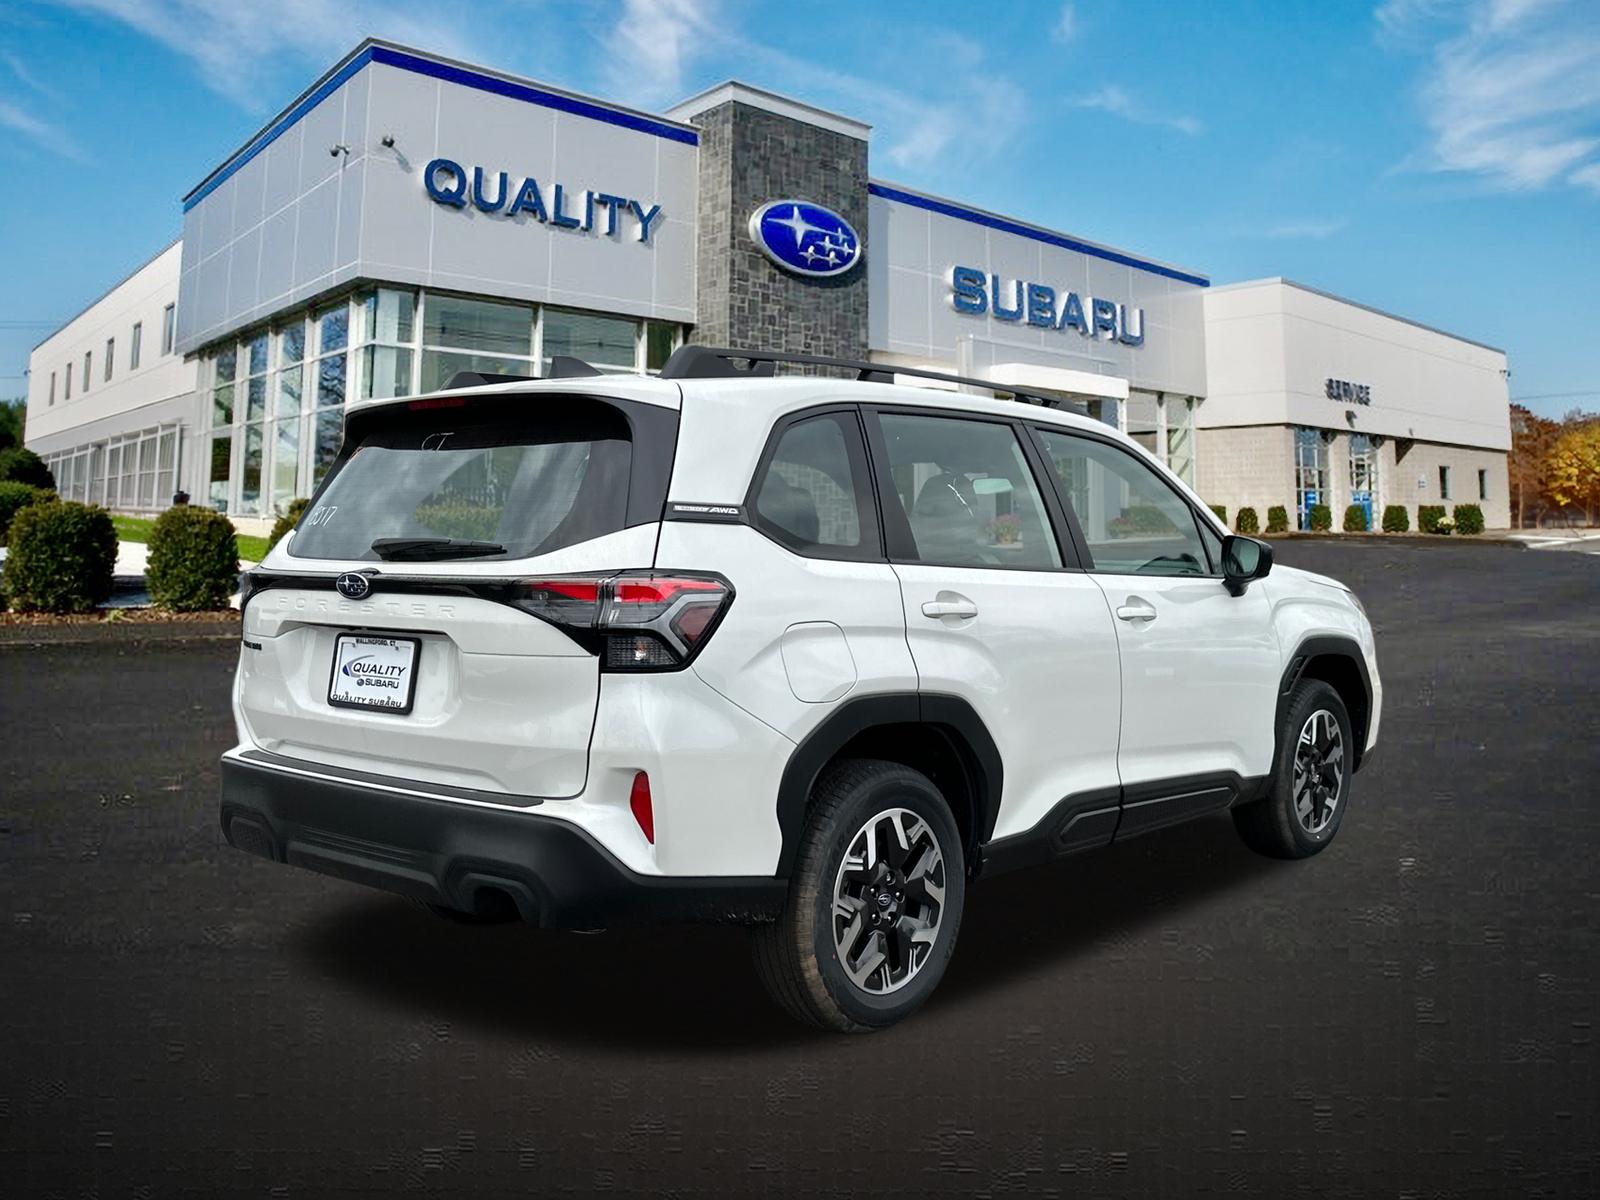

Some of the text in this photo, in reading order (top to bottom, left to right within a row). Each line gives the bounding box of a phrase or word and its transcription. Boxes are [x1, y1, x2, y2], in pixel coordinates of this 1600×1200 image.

[423, 157, 662, 243] QUALITY
[950, 265, 1145, 347] SUBARU
[278, 596, 456, 619] FORESTER
[353, 662, 406, 677] QUALITY
[365, 678, 400, 689] SUBARU
[332, 693, 402, 709] QUALITY SUBARU
